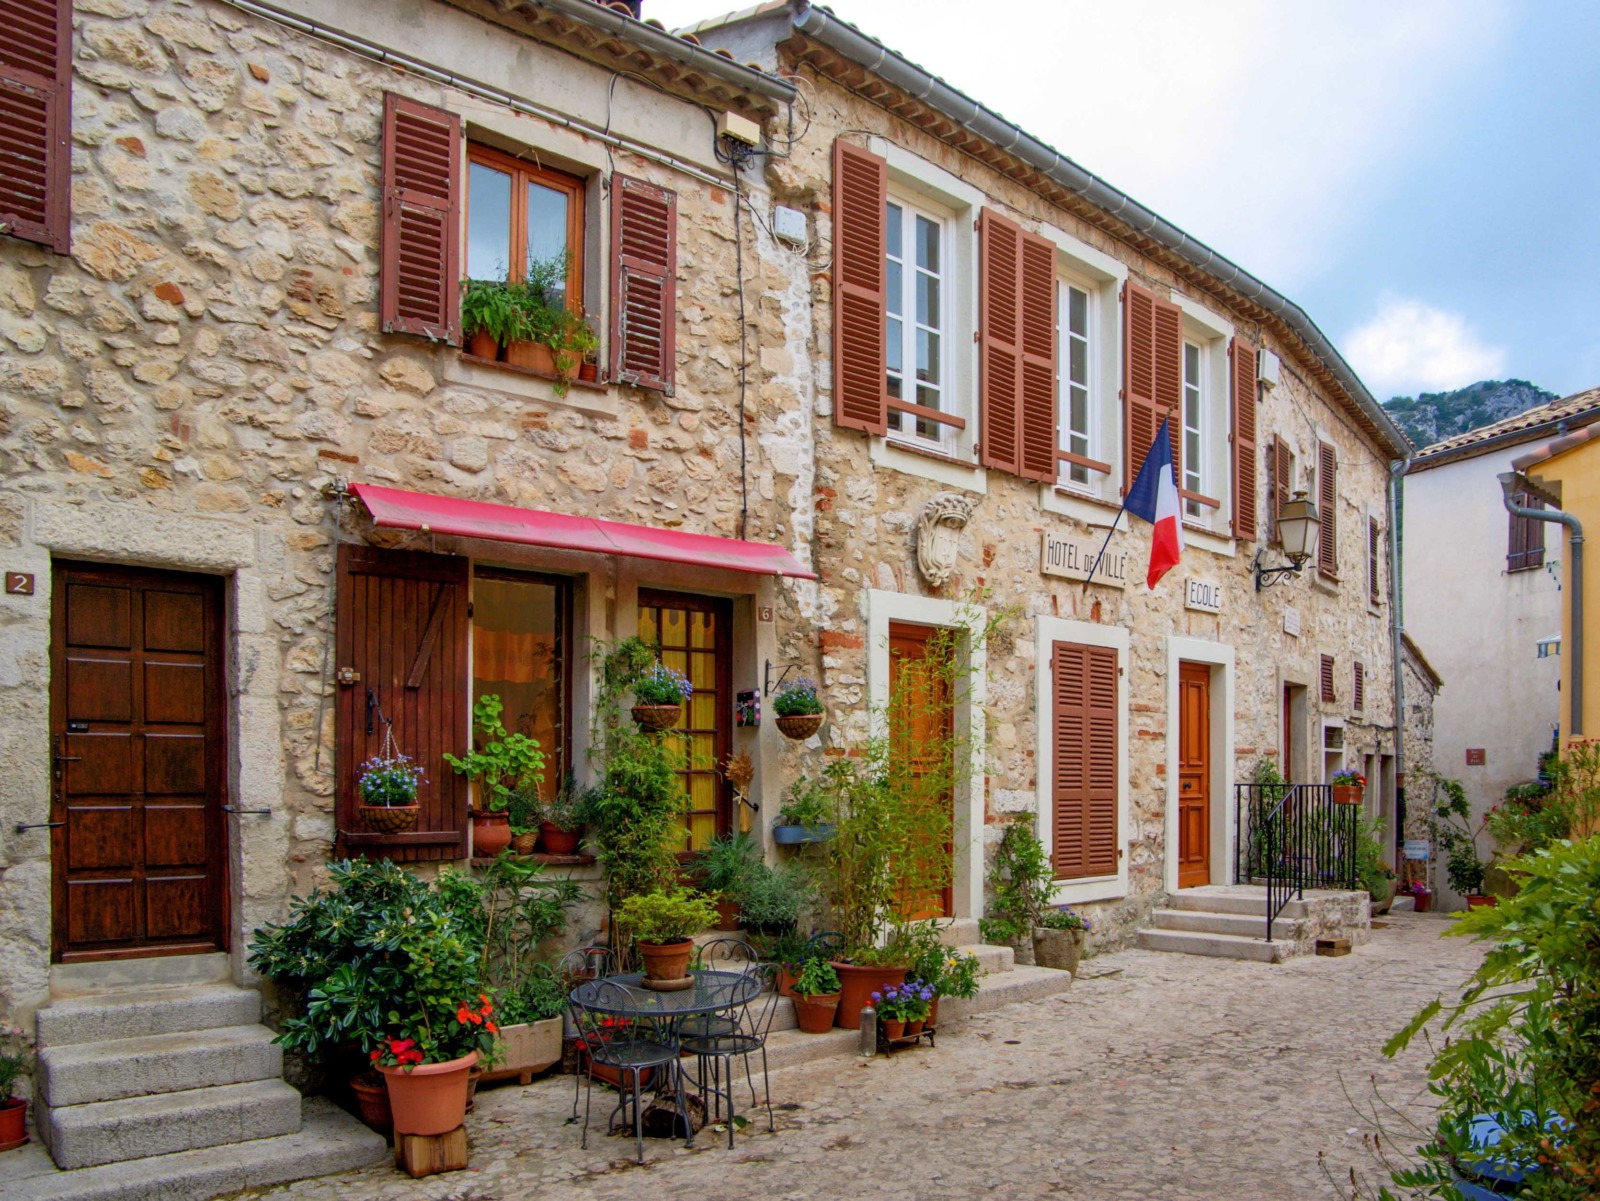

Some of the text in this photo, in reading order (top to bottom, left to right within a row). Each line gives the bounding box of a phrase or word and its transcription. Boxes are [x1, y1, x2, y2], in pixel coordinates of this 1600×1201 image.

[1047, 538, 1126, 580] HOTEL DE VILLE
[13, 574, 28, 592] 2
[1190, 581, 1220, 609] ECOLE
[762, 608, 770, 620] 6
